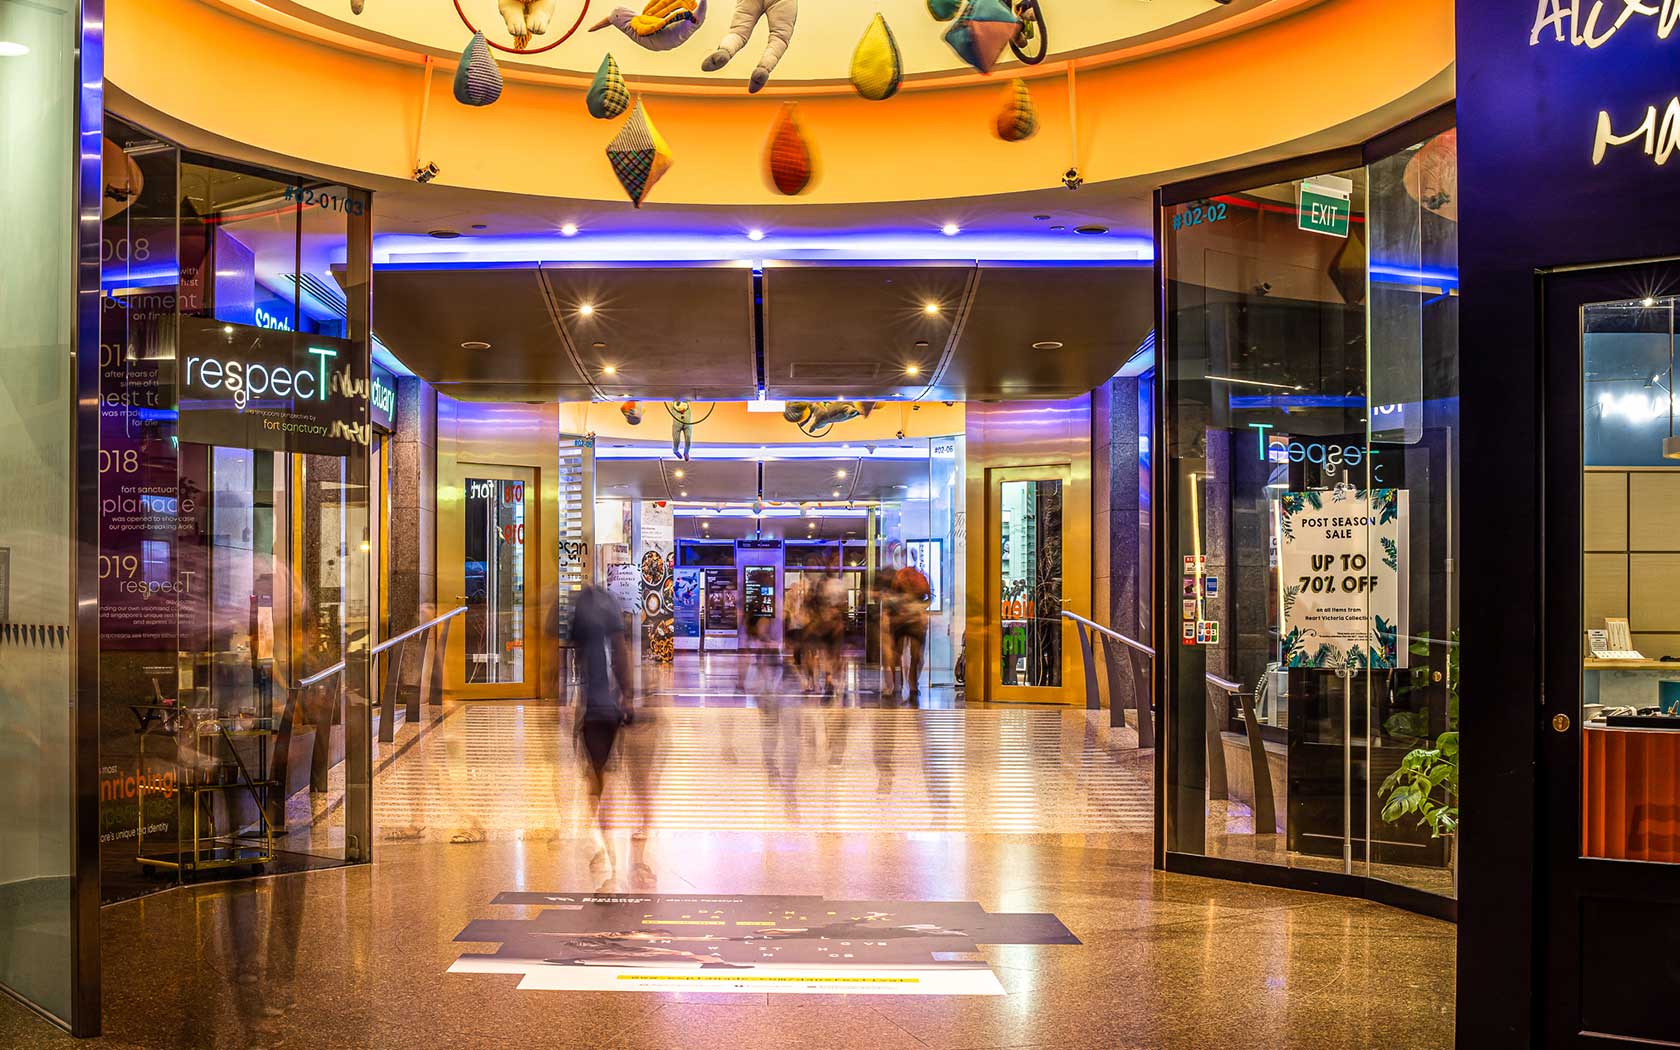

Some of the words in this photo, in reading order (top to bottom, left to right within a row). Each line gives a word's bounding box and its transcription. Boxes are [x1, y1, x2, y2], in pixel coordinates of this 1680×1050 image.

[1172, 203, 1227, 230] #02-02
[1311, 202, 1338, 227] EXIT
[186, 347, 338, 410] respecT
[264, 418, 281, 431] fort
[282, 422, 328, 437] sanctuary
[99, 450, 138, 473] 018
[121, 485, 136, 494] fort
[1302, 517, 1329, 528] POST
[1332, 516, 1376, 527] SEASON
[1326, 529, 1352, 539] SALE
[99, 556, 138, 579] 019
[1311, 554, 1335, 571] UP
[1340, 554, 1367, 571] TO
[1299, 575, 1336, 593] 70%
[1341, 575, 1378, 593] OFF
